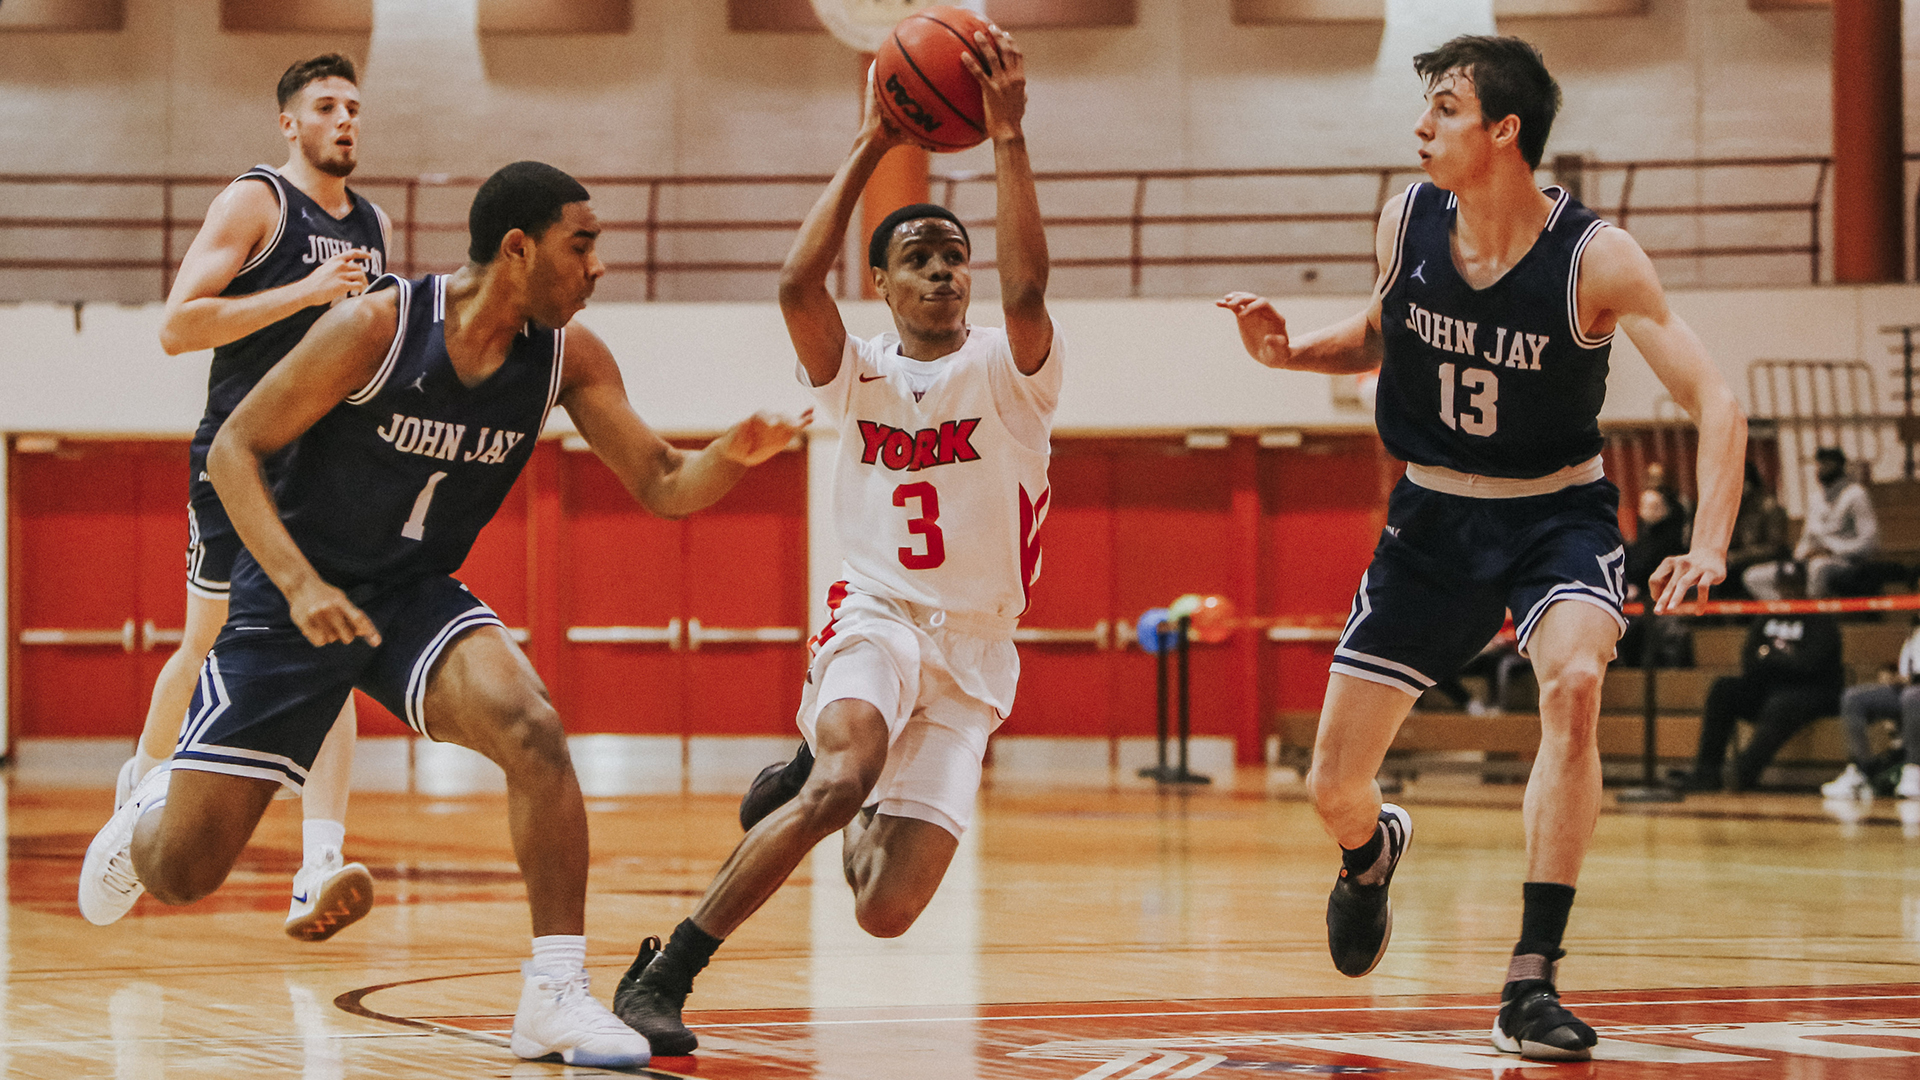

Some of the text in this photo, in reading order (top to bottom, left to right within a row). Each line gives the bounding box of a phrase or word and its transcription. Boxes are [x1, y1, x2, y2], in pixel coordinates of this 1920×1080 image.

[885, 73, 942, 133] NCAA
[1405, 302, 1550, 371] JOHN JAY
[1438, 362, 1499, 438] 13
[376, 413, 525, 464] JOHN JAY
[857, 417, 982, 472] YORK
[401, 471, 448, 541] 1
[892, 481, 946, 570] 3
